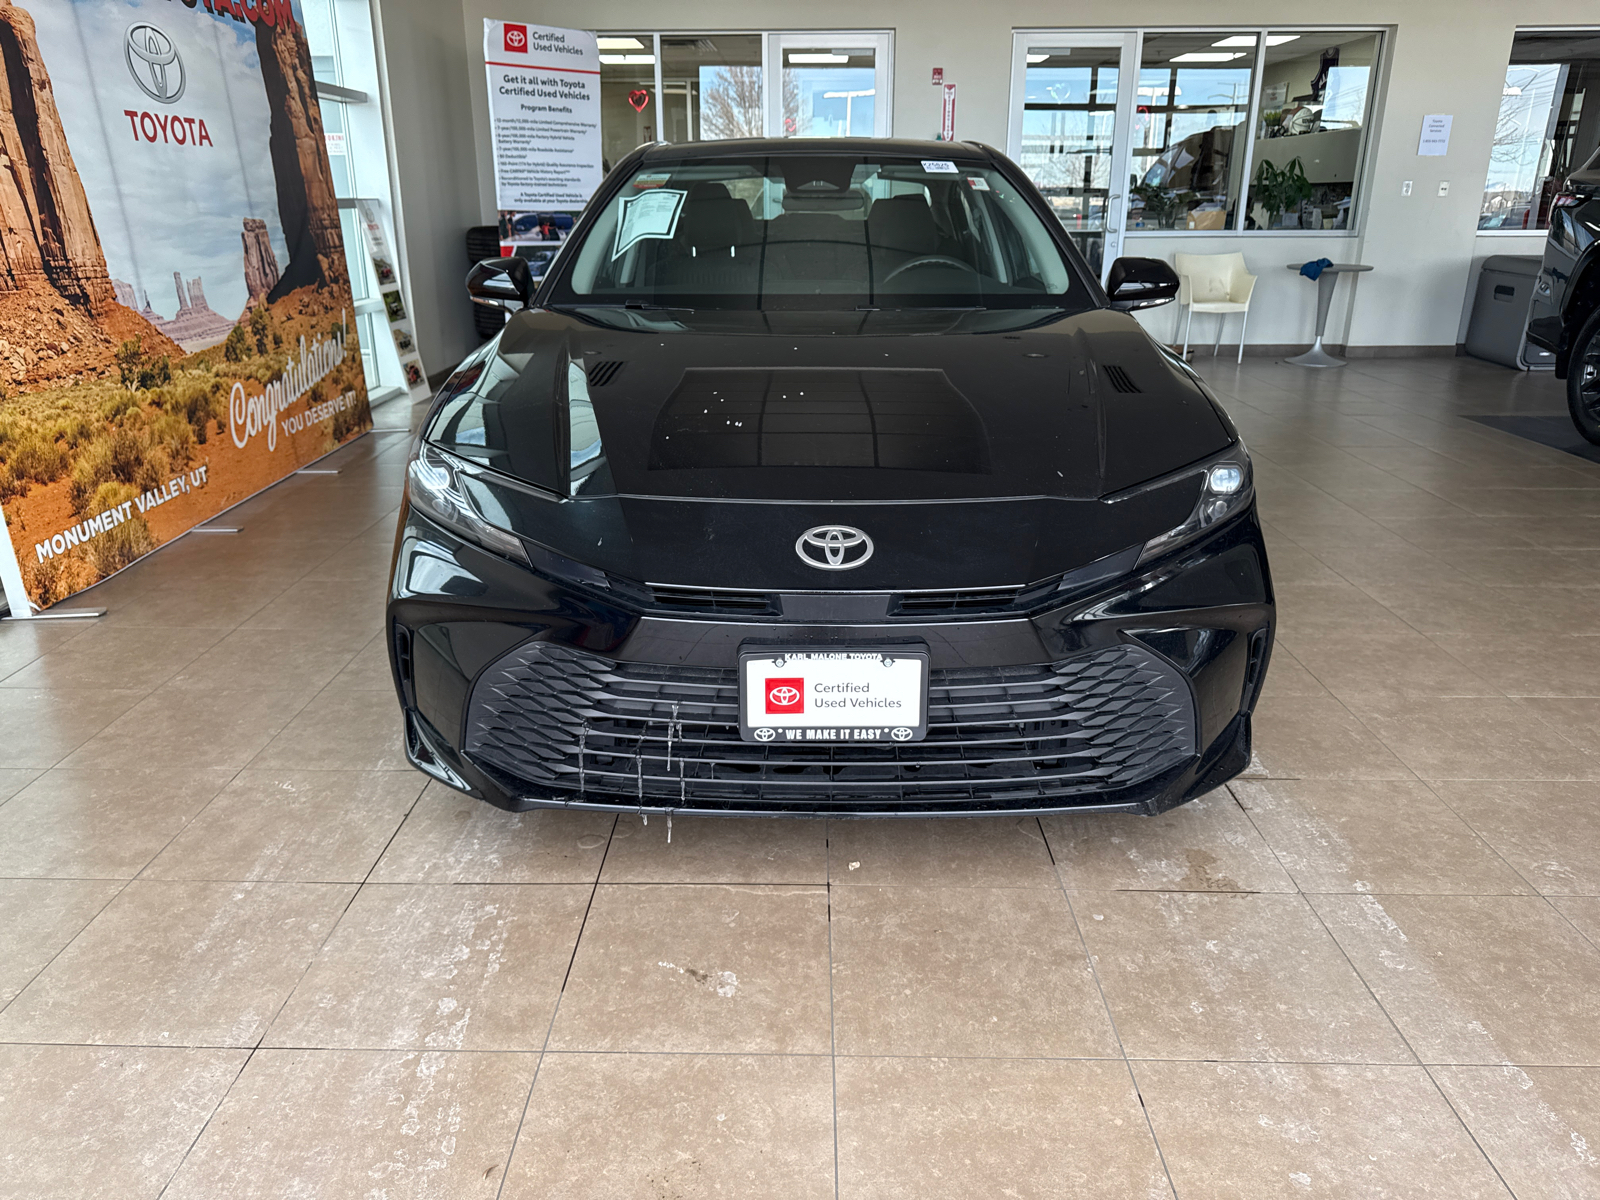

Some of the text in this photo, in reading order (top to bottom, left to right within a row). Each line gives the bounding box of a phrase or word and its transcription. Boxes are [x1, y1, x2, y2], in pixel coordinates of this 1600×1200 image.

[532, 31, 565, 43] Certified
[533, 42, 583, 56] Used Vehicles
[503, 74, 586, 90] Get it all with Toyota
[499, 86, 590, 101] Certified Used Vehicles
[520, 104, 573, 114] Program Benefits
[124, 109, 213, 147] TOYOTA
[230, 308, 347, 452] Congratulations!
[281, 390, 357, 437] YOU DESERVE IT!
[35, 465, 208, 564] MONUMENT VALLEY, UT
[784, 653, 883, 661] KARL MALONE TOYOTA
[814, 682, 870, 693] Certified
[814, 697, 902, 708] Used Vehicles
[785, 729, 882, 740] WE MAKE IT EASY
